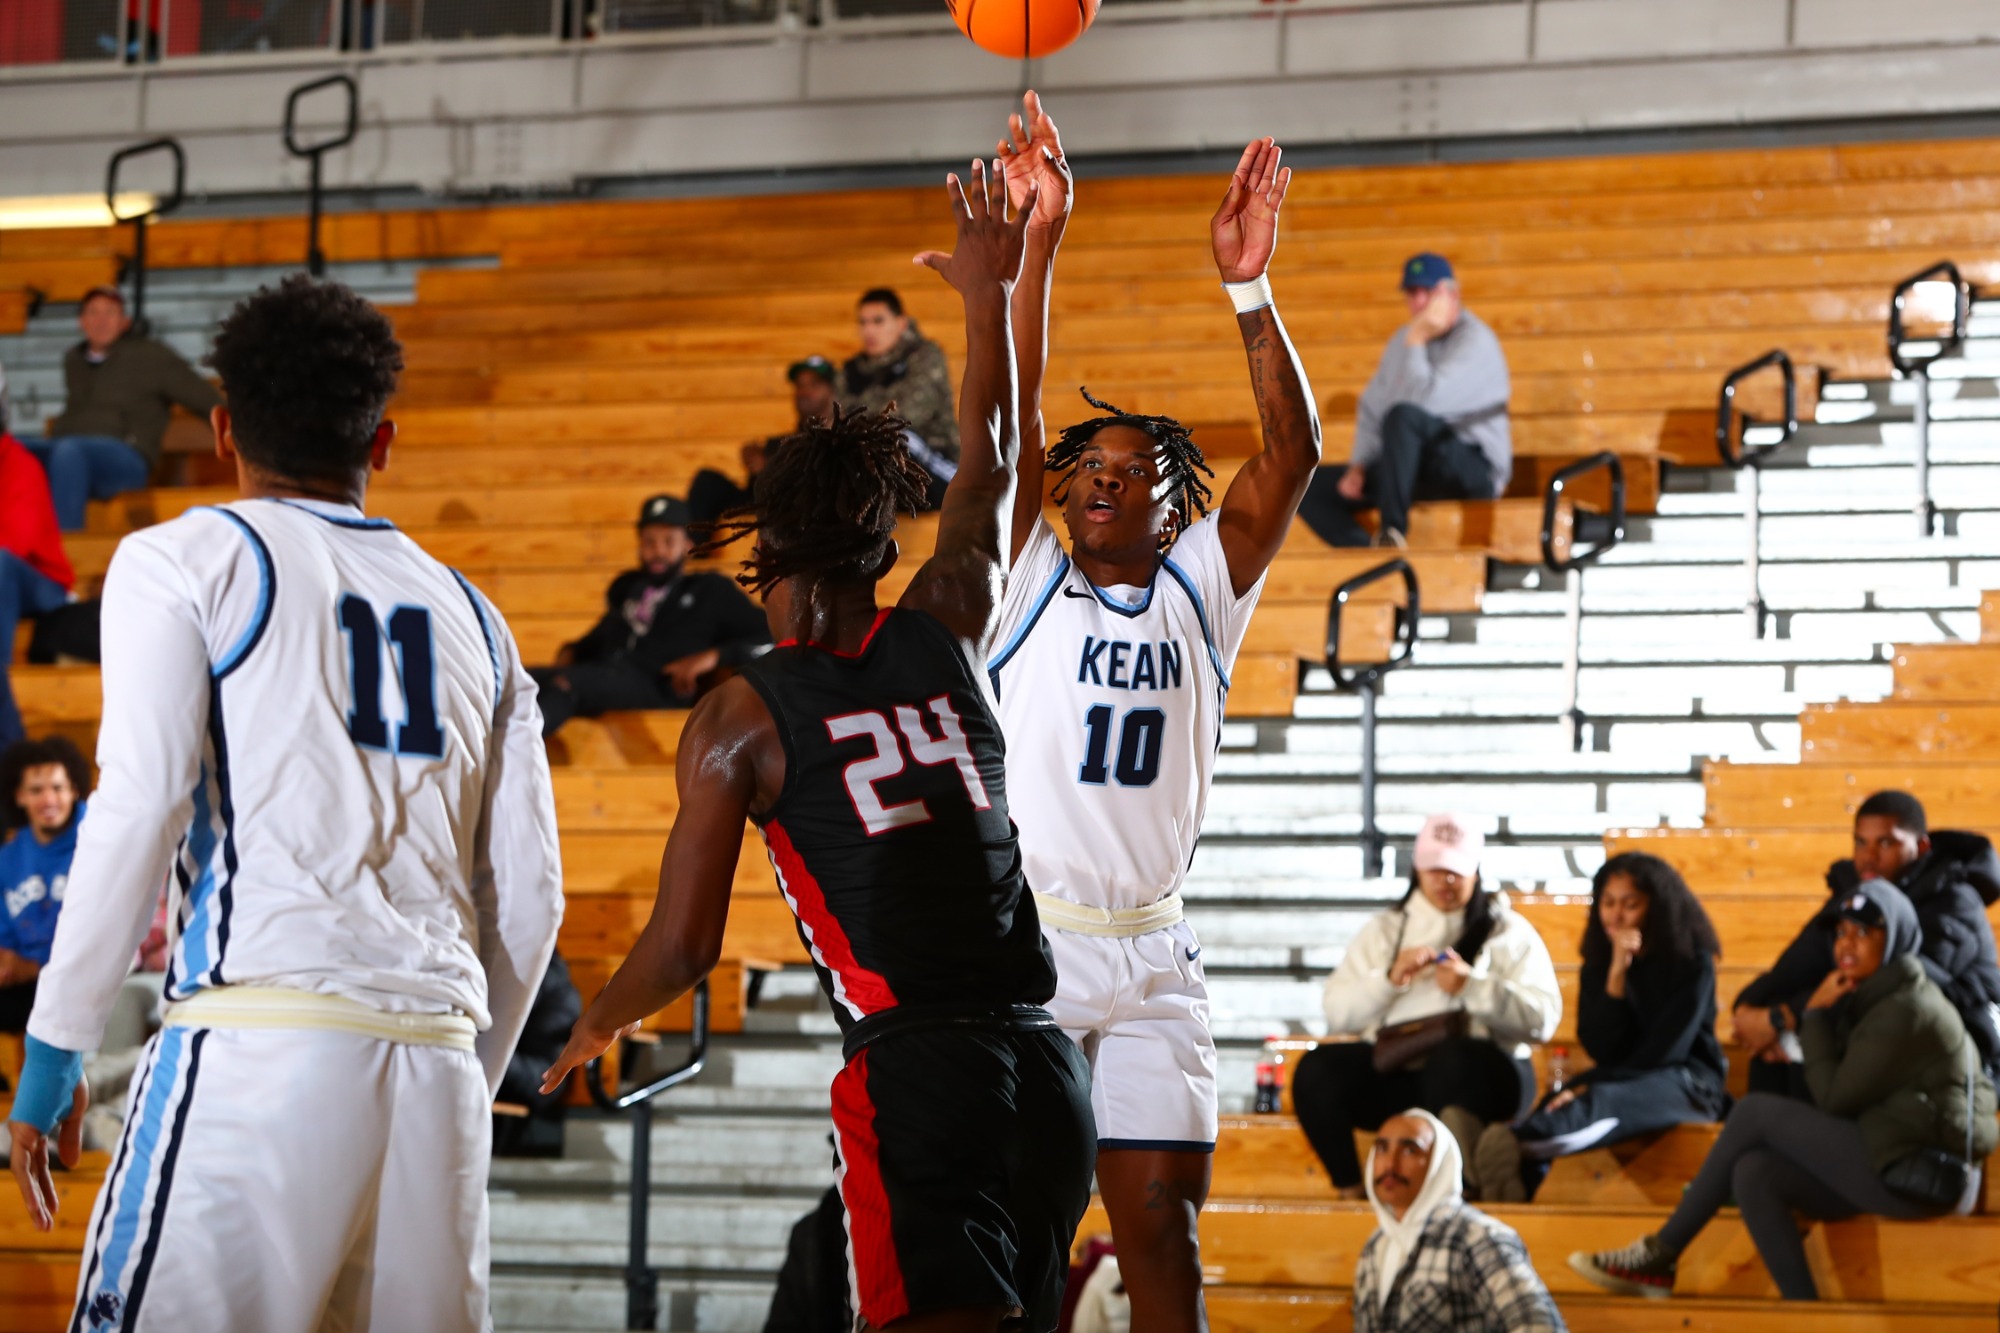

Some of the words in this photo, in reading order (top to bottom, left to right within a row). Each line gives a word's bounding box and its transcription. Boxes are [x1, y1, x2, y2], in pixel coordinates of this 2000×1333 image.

[338, 592, 444, 761] 11
[1078, 634, 1182, 690] KEAN
[823, 693, 992, 836] 24
[1077, 702, 1166, 788] 10
